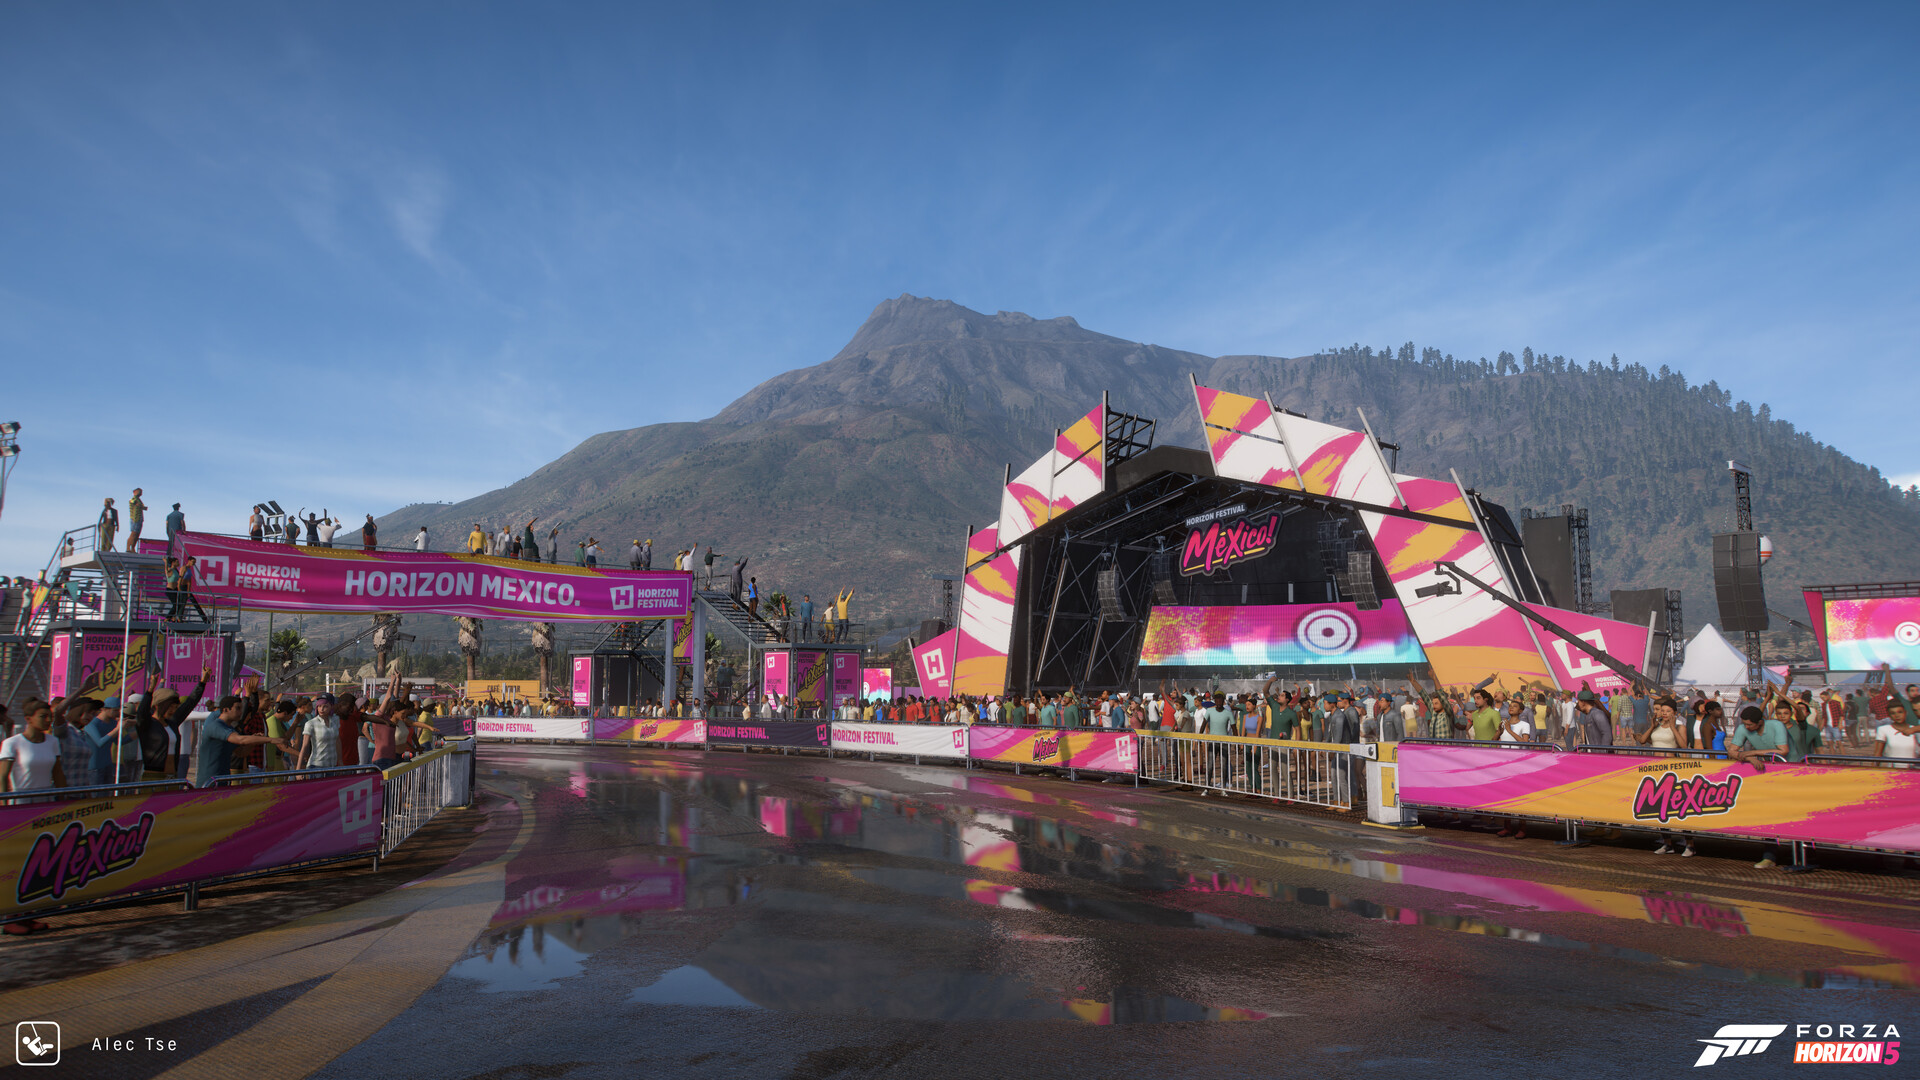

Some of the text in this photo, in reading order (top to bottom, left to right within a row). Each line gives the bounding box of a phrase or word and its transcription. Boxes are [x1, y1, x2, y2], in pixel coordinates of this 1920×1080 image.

[1186, 504, 1246, 527] HORIZON FESTIVAL
[235, 561, 301, 579] HORIZON
[235, 575, 306, 593] FESTIVAL.
[344, 570, 581, 607] HORIZON MEXICO.
[637, 588, 680, 599] HORIZON
[637, 598, 683, 609] FESTIVAL.
[85, 636, 124, 644] HORIZON
[170, 674, 216, 683] BIENVENO
[477, 722, 537, 733] HORIZON FESTIVAL.
[708, 725, 770, 740] HORIZON FESTIVAL.
[832, 728, 899, 746] HORIZON FESTIVAL.
[1638, 761, 1703, 773] HORIZON FESTIVAL
[32, 801, 115, 830] HORIZON FESTIVAL
